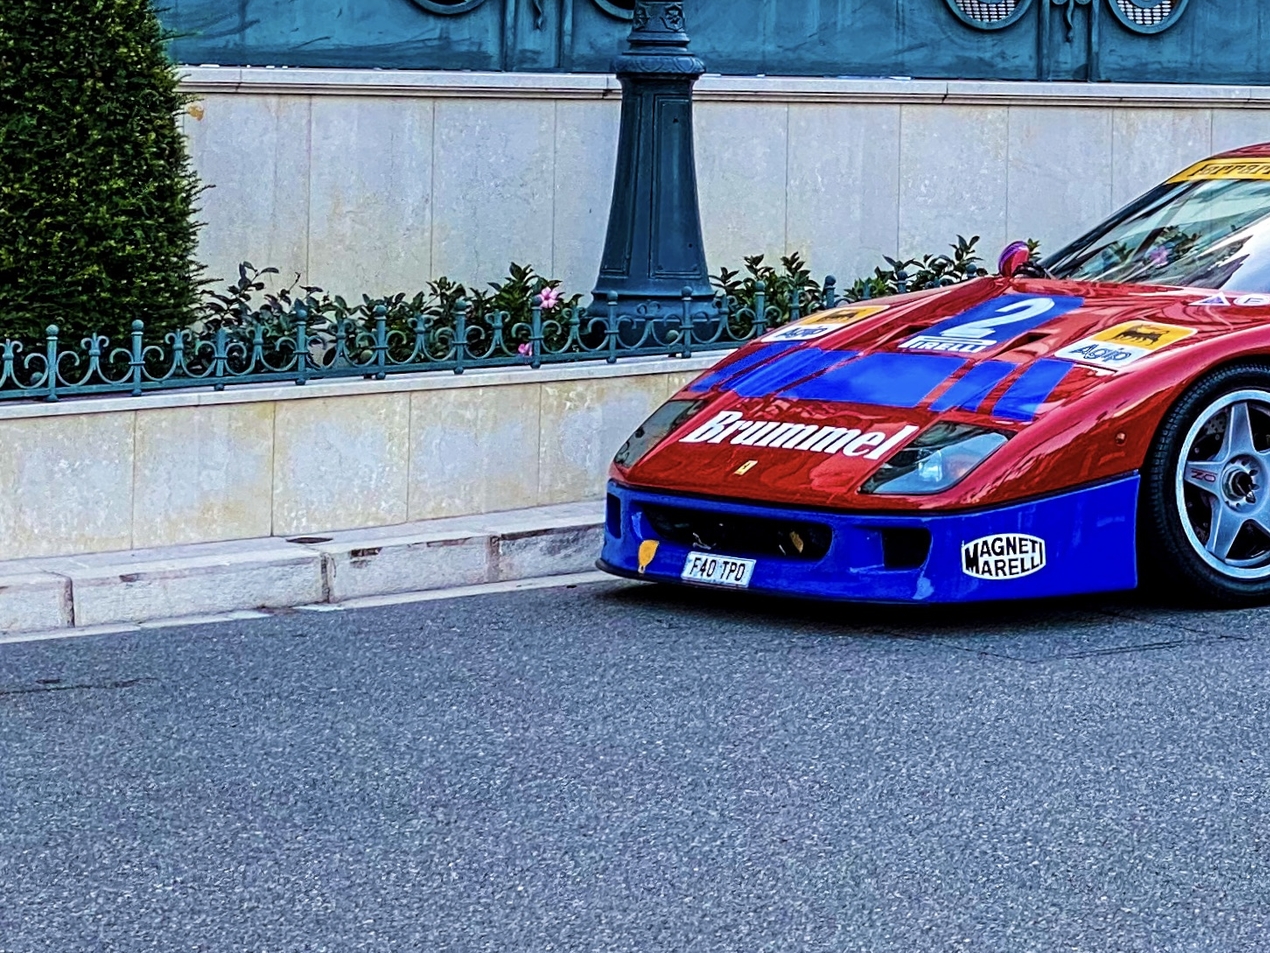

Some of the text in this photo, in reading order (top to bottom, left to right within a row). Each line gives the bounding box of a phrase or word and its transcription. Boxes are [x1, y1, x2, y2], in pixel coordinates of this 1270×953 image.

[941, 297, 1055, 338] 2
[898, 335, 997, 353] PIRELLI
[1068, 344, 1132, 363] Agip
[679, 411, 920, 460] Brummel
[964, 536, 1043, 559] MAGNETI
[690, 557, 717, 578] F40
[964, 556, 1043, 577] MARELLI
